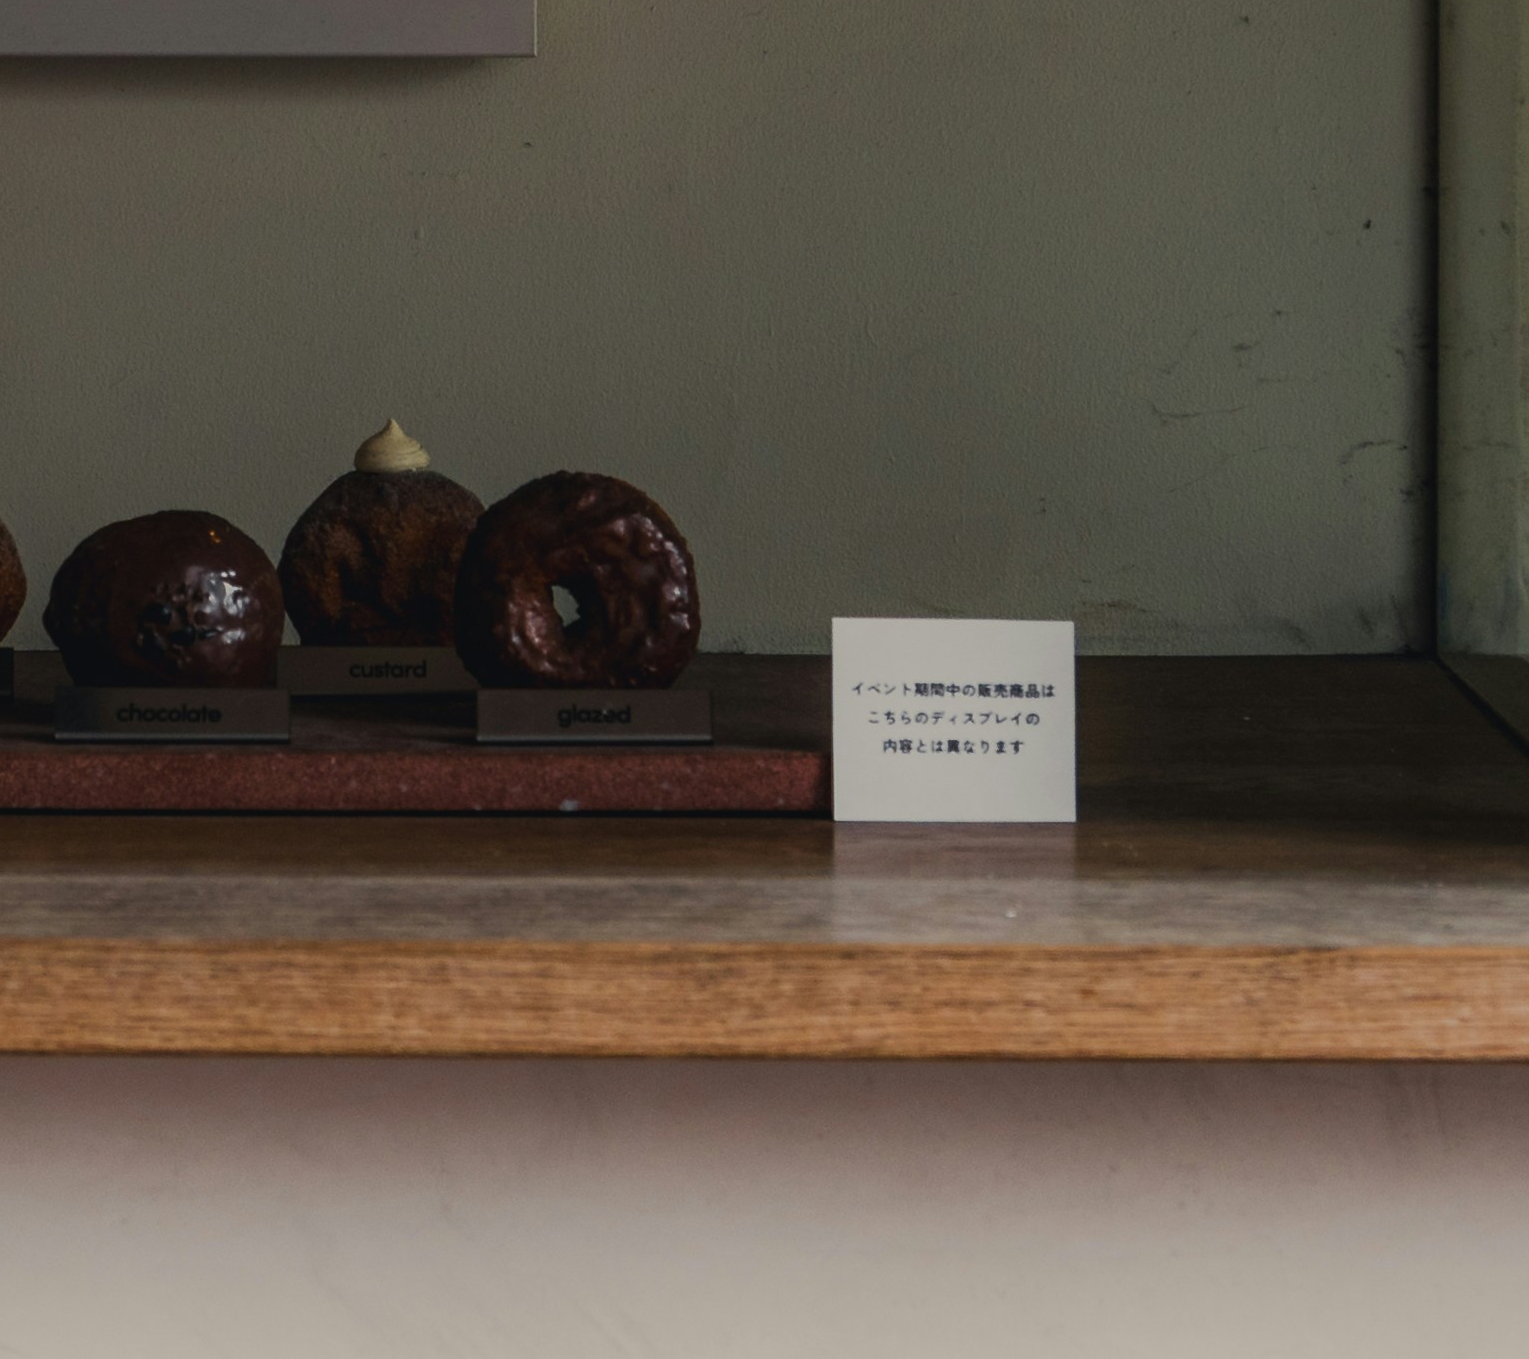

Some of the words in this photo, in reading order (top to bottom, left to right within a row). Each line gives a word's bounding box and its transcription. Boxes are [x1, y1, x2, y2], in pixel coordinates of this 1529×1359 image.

[349, 660, 427, 678] custard
[116, 703, 222, 723] chocolate
[557, 704, 631, 727] glazed
[868, 710, 1041, 726] こちらのディスプレイの
[883, 739, 1025, 755] 内容とは異なります
